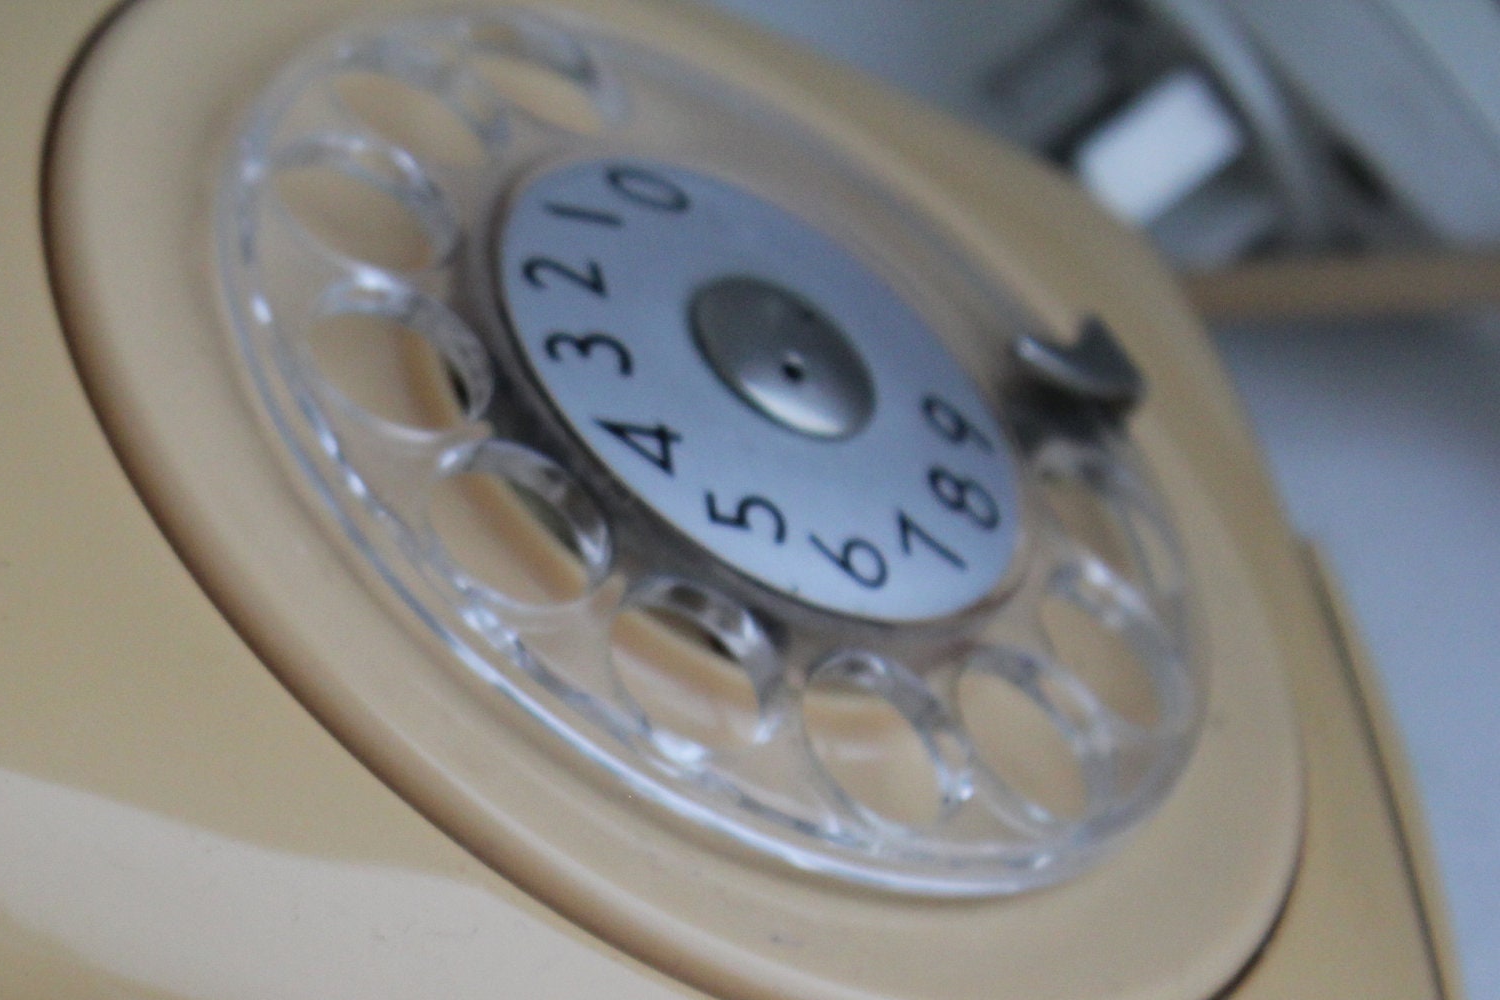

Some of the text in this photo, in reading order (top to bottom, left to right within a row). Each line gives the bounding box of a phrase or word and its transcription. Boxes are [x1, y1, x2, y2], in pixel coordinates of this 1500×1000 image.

[543, 201, 625, 227] 1
[605, 163, 691, 213] 0
[521, 256, 609, 299] 2
[544, 330, 634, 377] 3
[595, 418, 683, 477] 4
[921, 393, 993, 455] 9
[704, 490, 787, 545] 5
[927, 465, 1000, 531] 8
[807, 532, 889, 590] 6
[896, 507, 970, 572] 7
